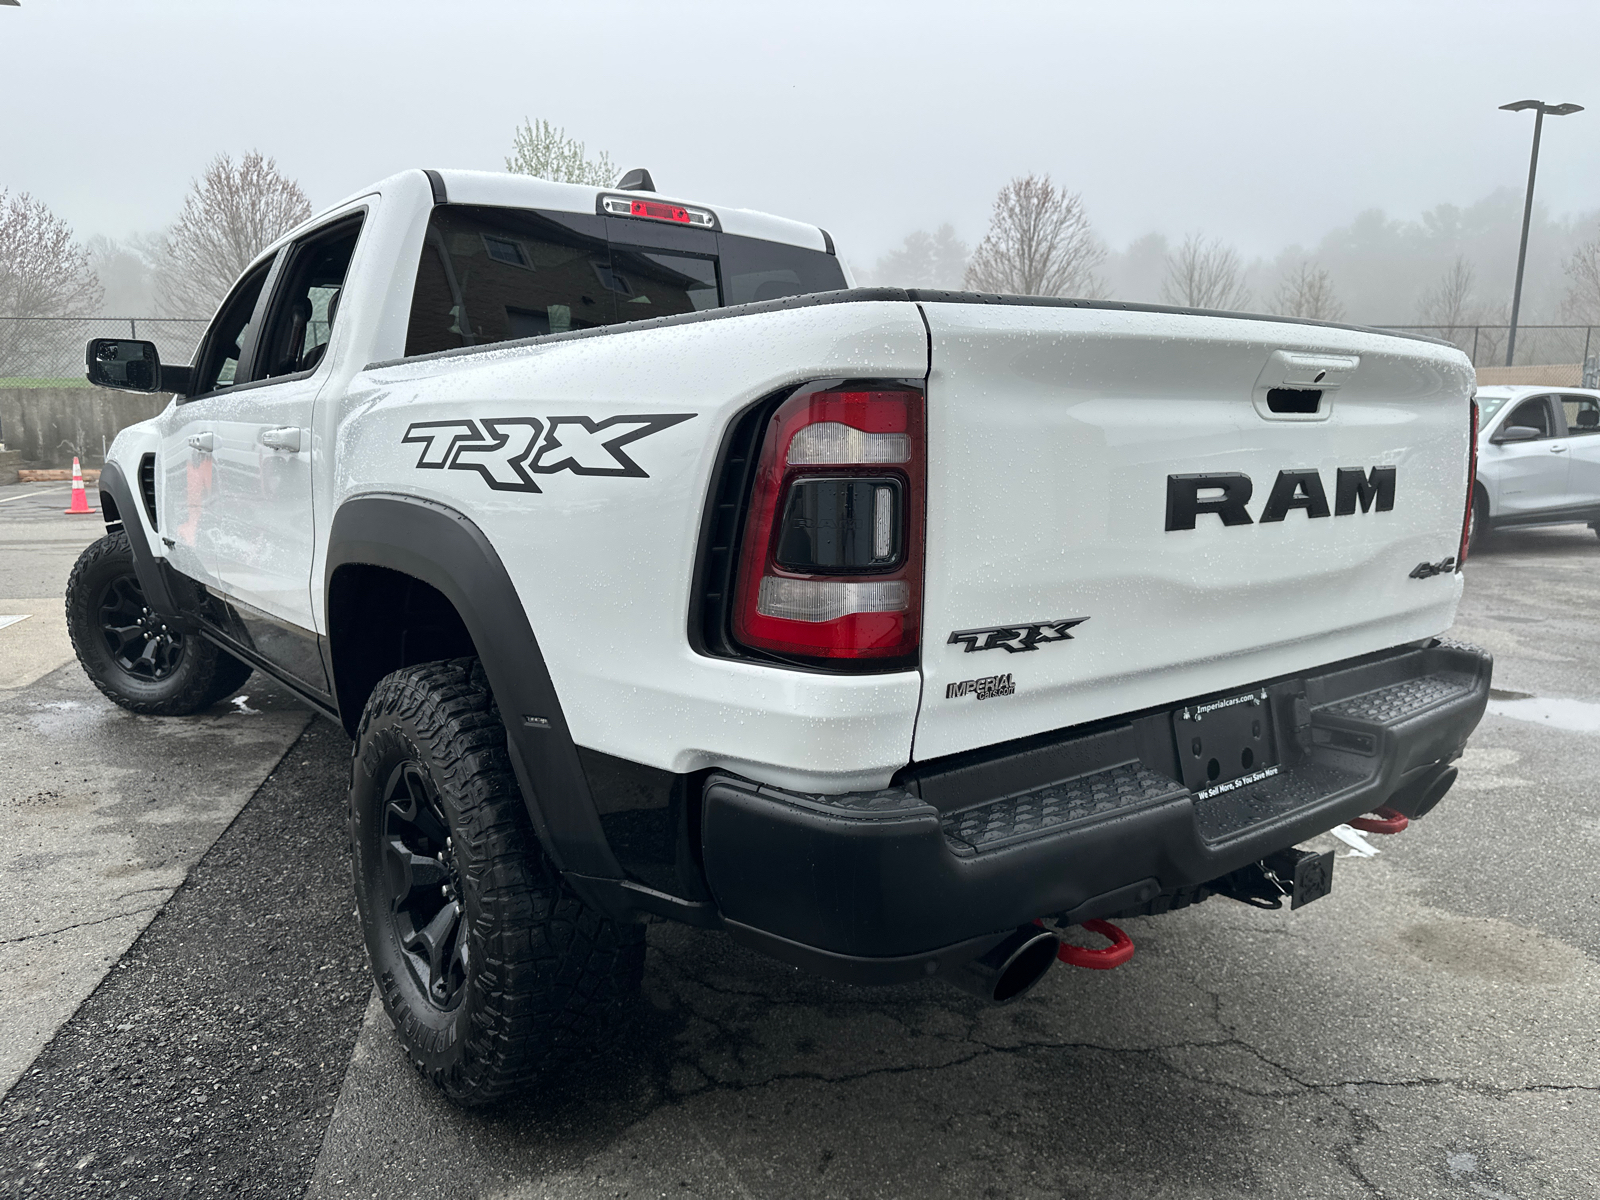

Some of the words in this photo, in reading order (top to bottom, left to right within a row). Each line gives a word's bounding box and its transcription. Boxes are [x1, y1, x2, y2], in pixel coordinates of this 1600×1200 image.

[400, 413, 698, 493] TRX
[1165, 465, 1396, 532] RAM
[793, 517, 863, 530] RAM
[947, 616, 1091, 653] TRX
[945, 673, 1016, 699] IMPERIAL
[977, 687, 1015, 700] cars.com
[1197, 694, 1254, 713] Imperialcars.com
[1198, 791, 1208, 800] We
[1208, 787, 1219, 798] Sell
[1219, 782, 1235, 793] More,
[1234, 778, 1242, 788] So
[1241, 775, 1253, 785] You
[1252, 772, 1265, 782] Save
[1265, 767, 1279, 777] More
